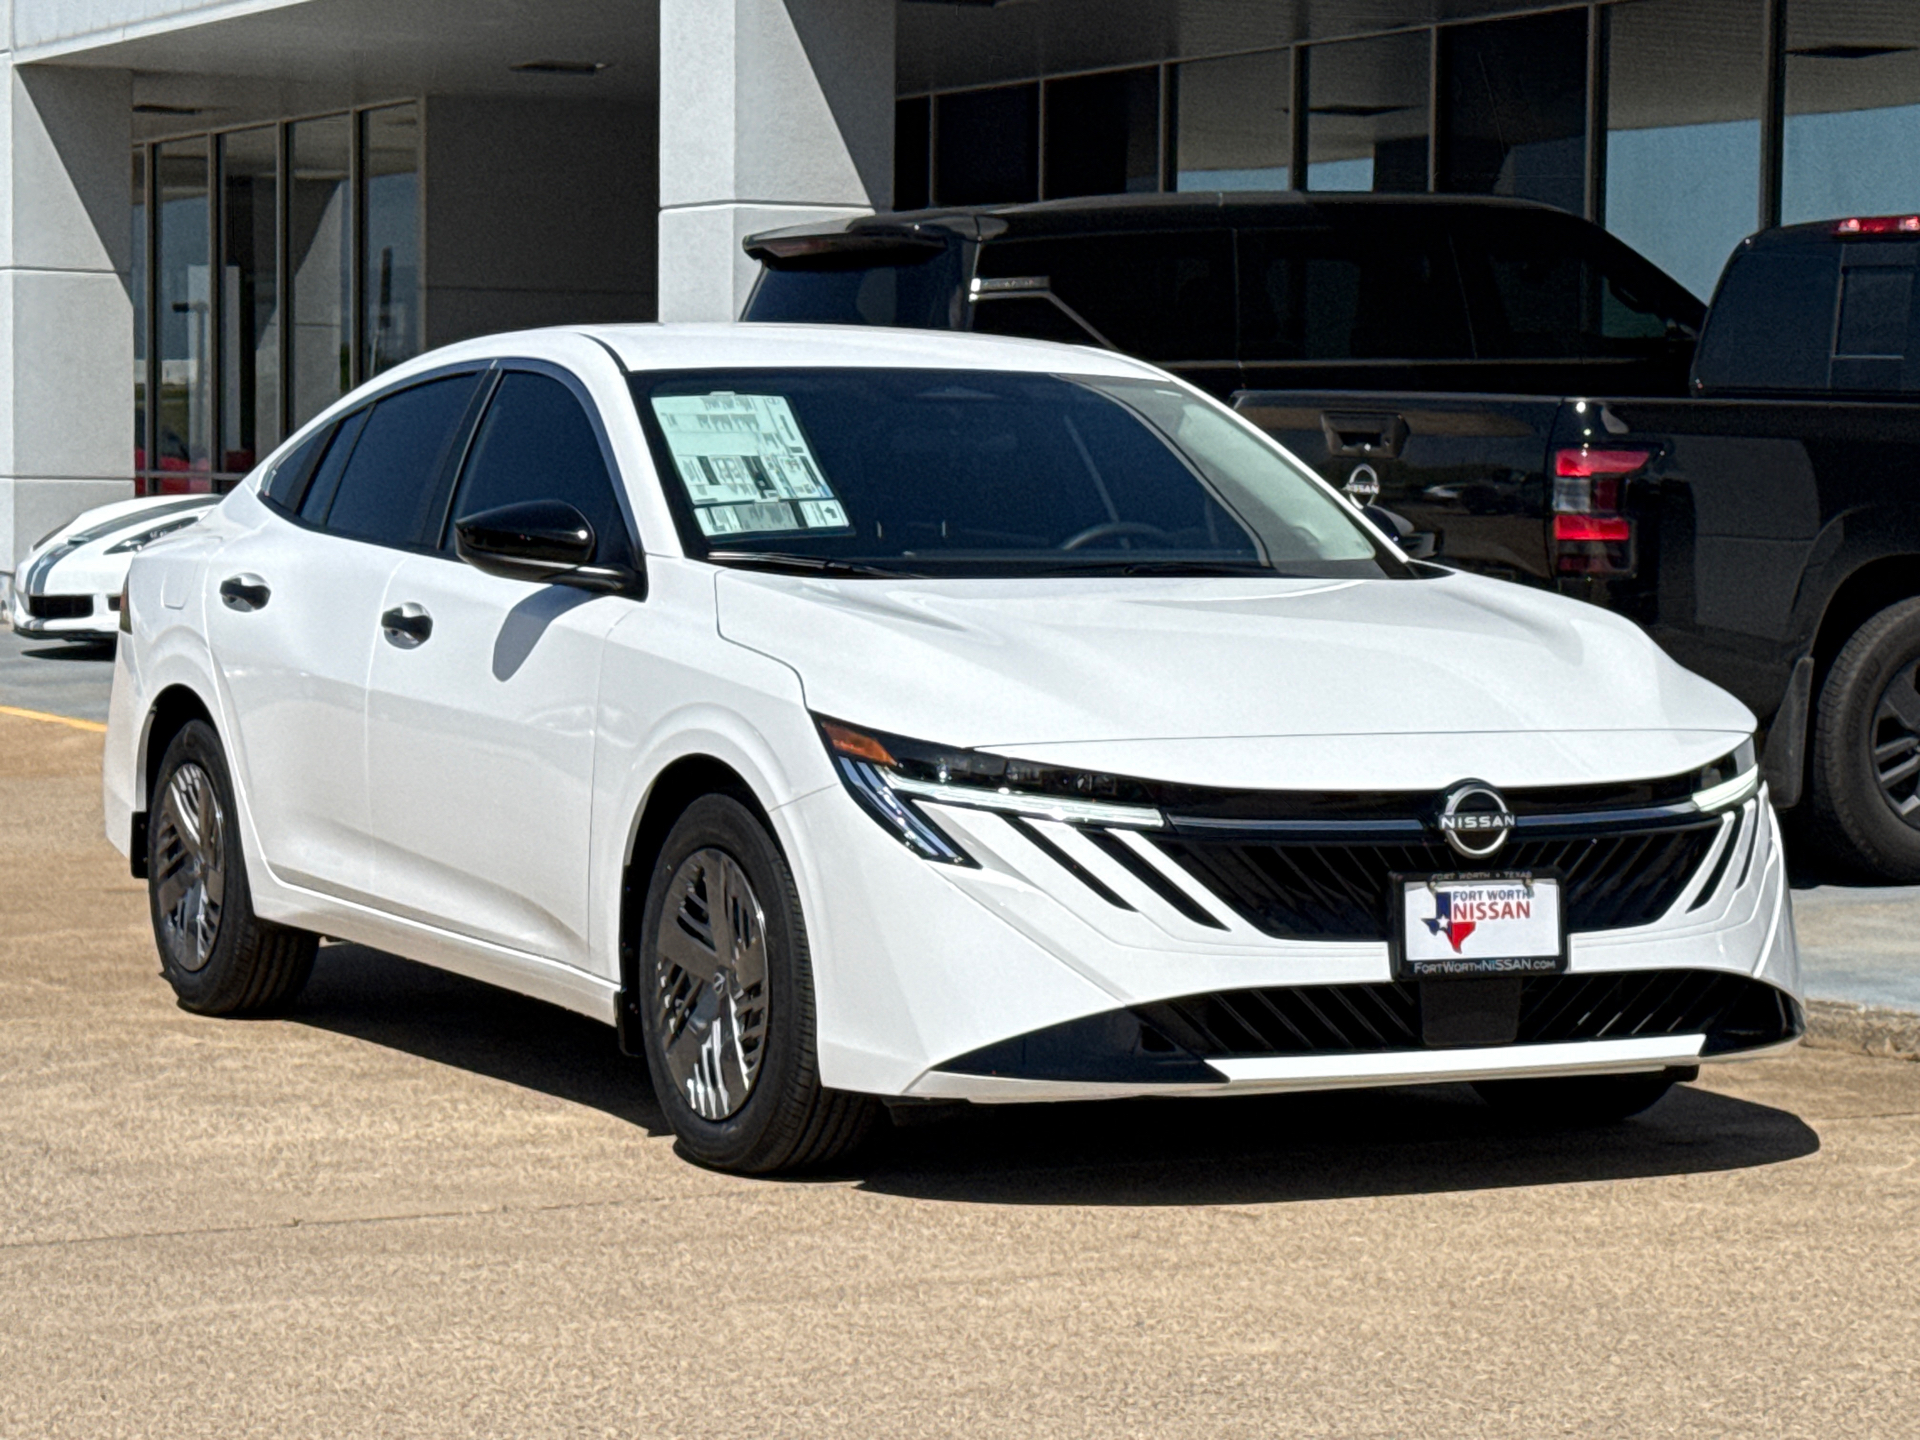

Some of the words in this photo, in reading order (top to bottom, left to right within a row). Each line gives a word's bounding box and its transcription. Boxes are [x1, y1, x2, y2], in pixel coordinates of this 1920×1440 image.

[1441, 815, 1516, 829] NISSAN
[1459, 872, 1490, 880] WORTH
[1503, 871, 1533, 879] TEXAS
[1453, 890, 1484, 901] FORT
[1487, 889, 1529, 900] WORTH
[1453, 901, 1530, 920] NISSAN
